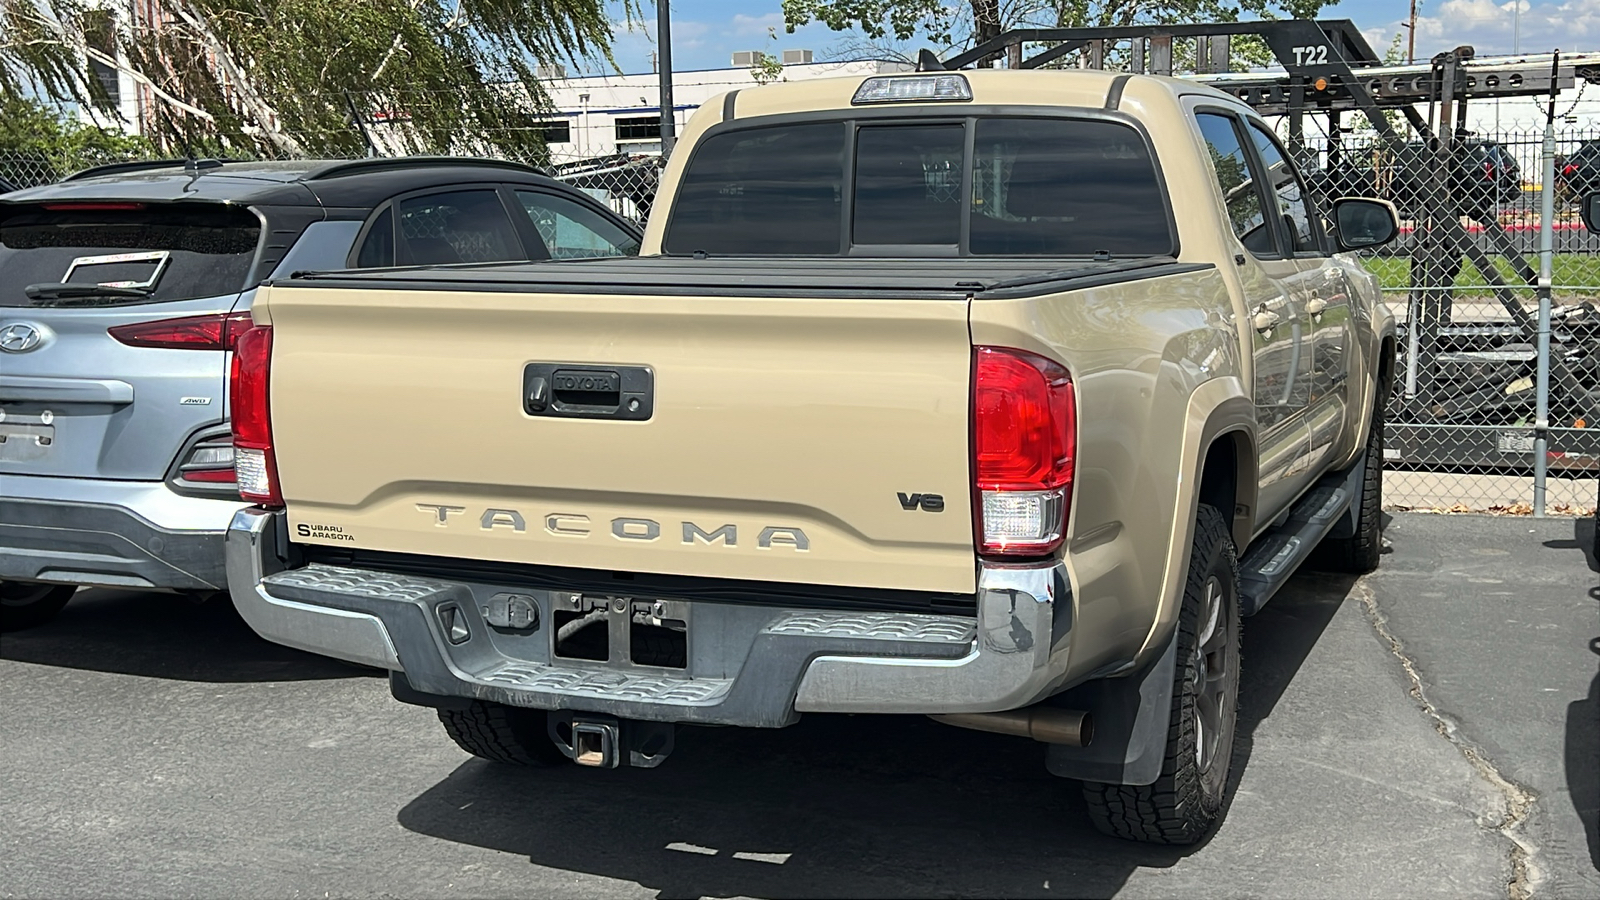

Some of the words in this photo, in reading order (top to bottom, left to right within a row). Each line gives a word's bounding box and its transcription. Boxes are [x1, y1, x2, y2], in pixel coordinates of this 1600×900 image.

[1292, 45, 1328, 67] T22
[556, 375, 612, 390] TOYOTA
[896, 491, 945, 513] V6
[415, 503, 811, 552] TACOMA
